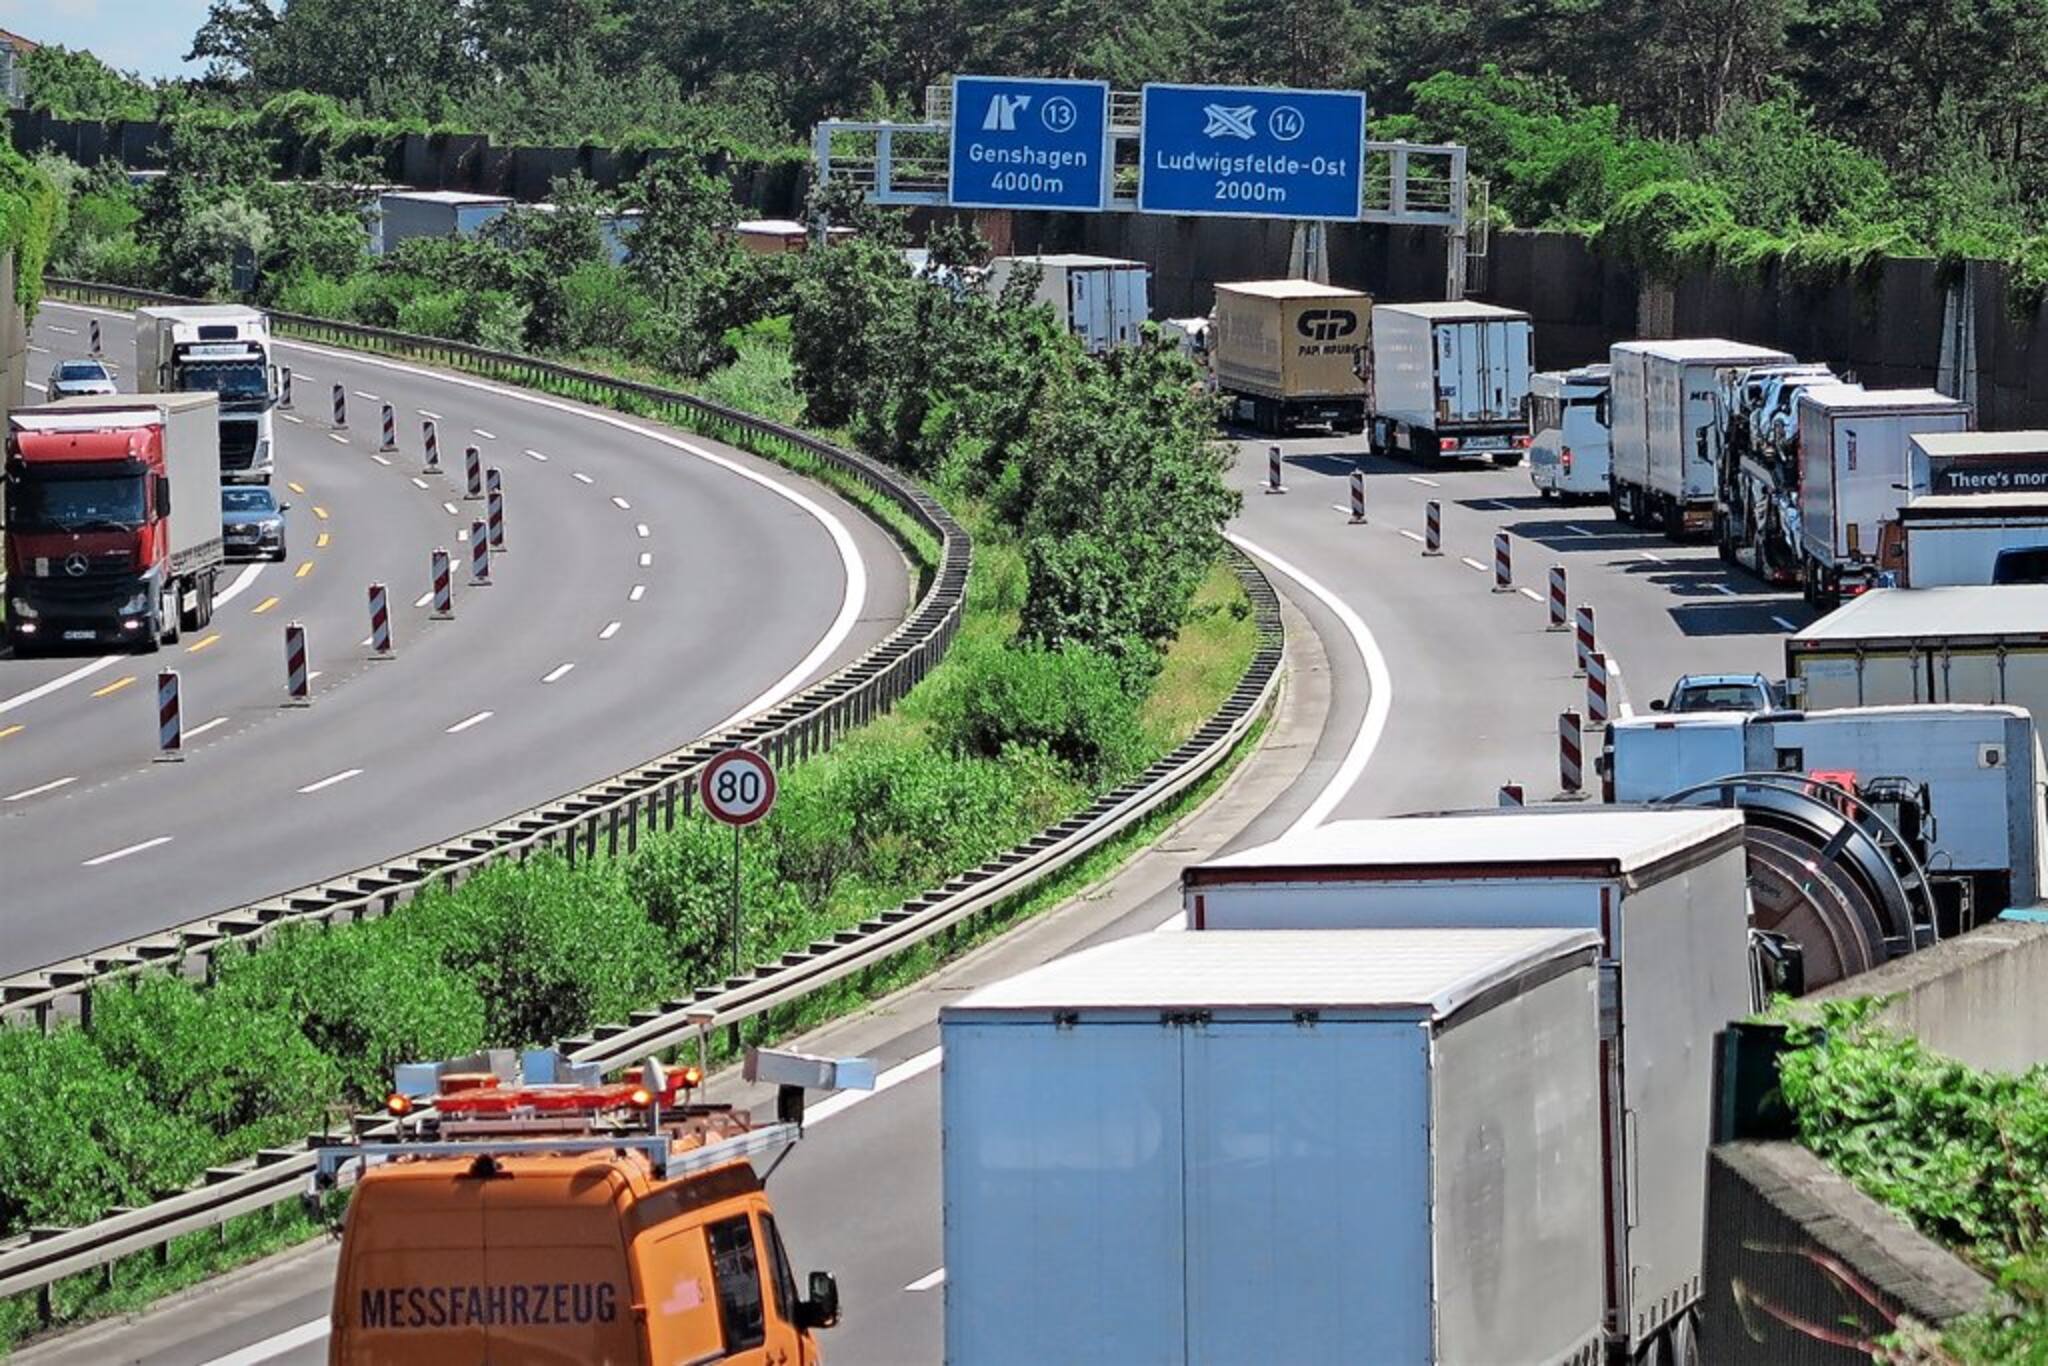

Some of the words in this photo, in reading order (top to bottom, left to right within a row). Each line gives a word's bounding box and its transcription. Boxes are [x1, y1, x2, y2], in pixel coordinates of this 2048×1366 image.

[1049, 104, 1071, 125] 13
[1275, 113, 1297, 133] 14
[969, 143, 1087, 170] Genshagen
[1157, 150, 1346, 176] Ludwigsfelde-Ost
[991, 171, 1063, 193] 4000m
[1215, 180, 1287, 202] 2000m
[1948, 471, 2010, 488] There's
[717, 770, 760, 804] 80
[361, 1282, 617, 1329] MESSFAHRZEUG
